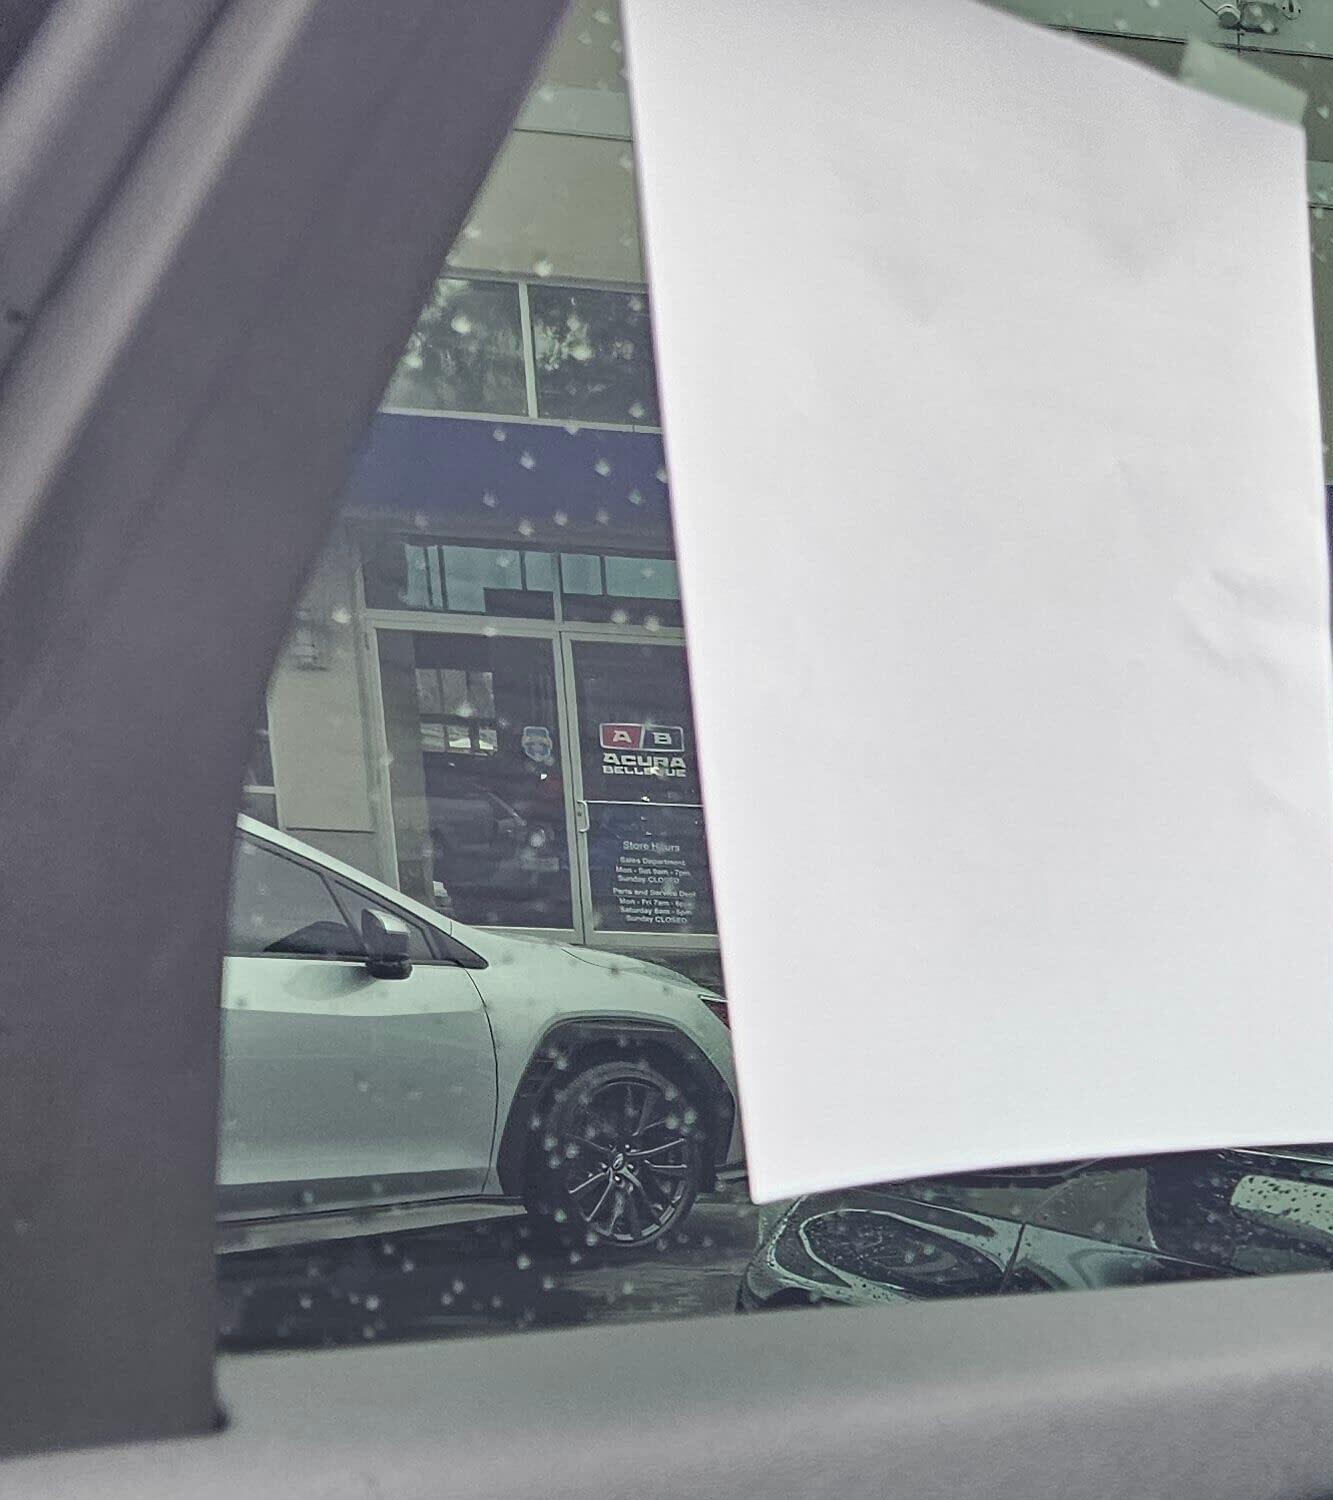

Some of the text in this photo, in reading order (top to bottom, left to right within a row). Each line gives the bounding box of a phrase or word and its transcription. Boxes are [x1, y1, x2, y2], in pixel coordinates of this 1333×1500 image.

[612, 730, 672, 745] A B
[602, 752, 686, 769] ACURA
[623, 841, 650, 851] Store
[648, 876, 680, 884] CLOD
